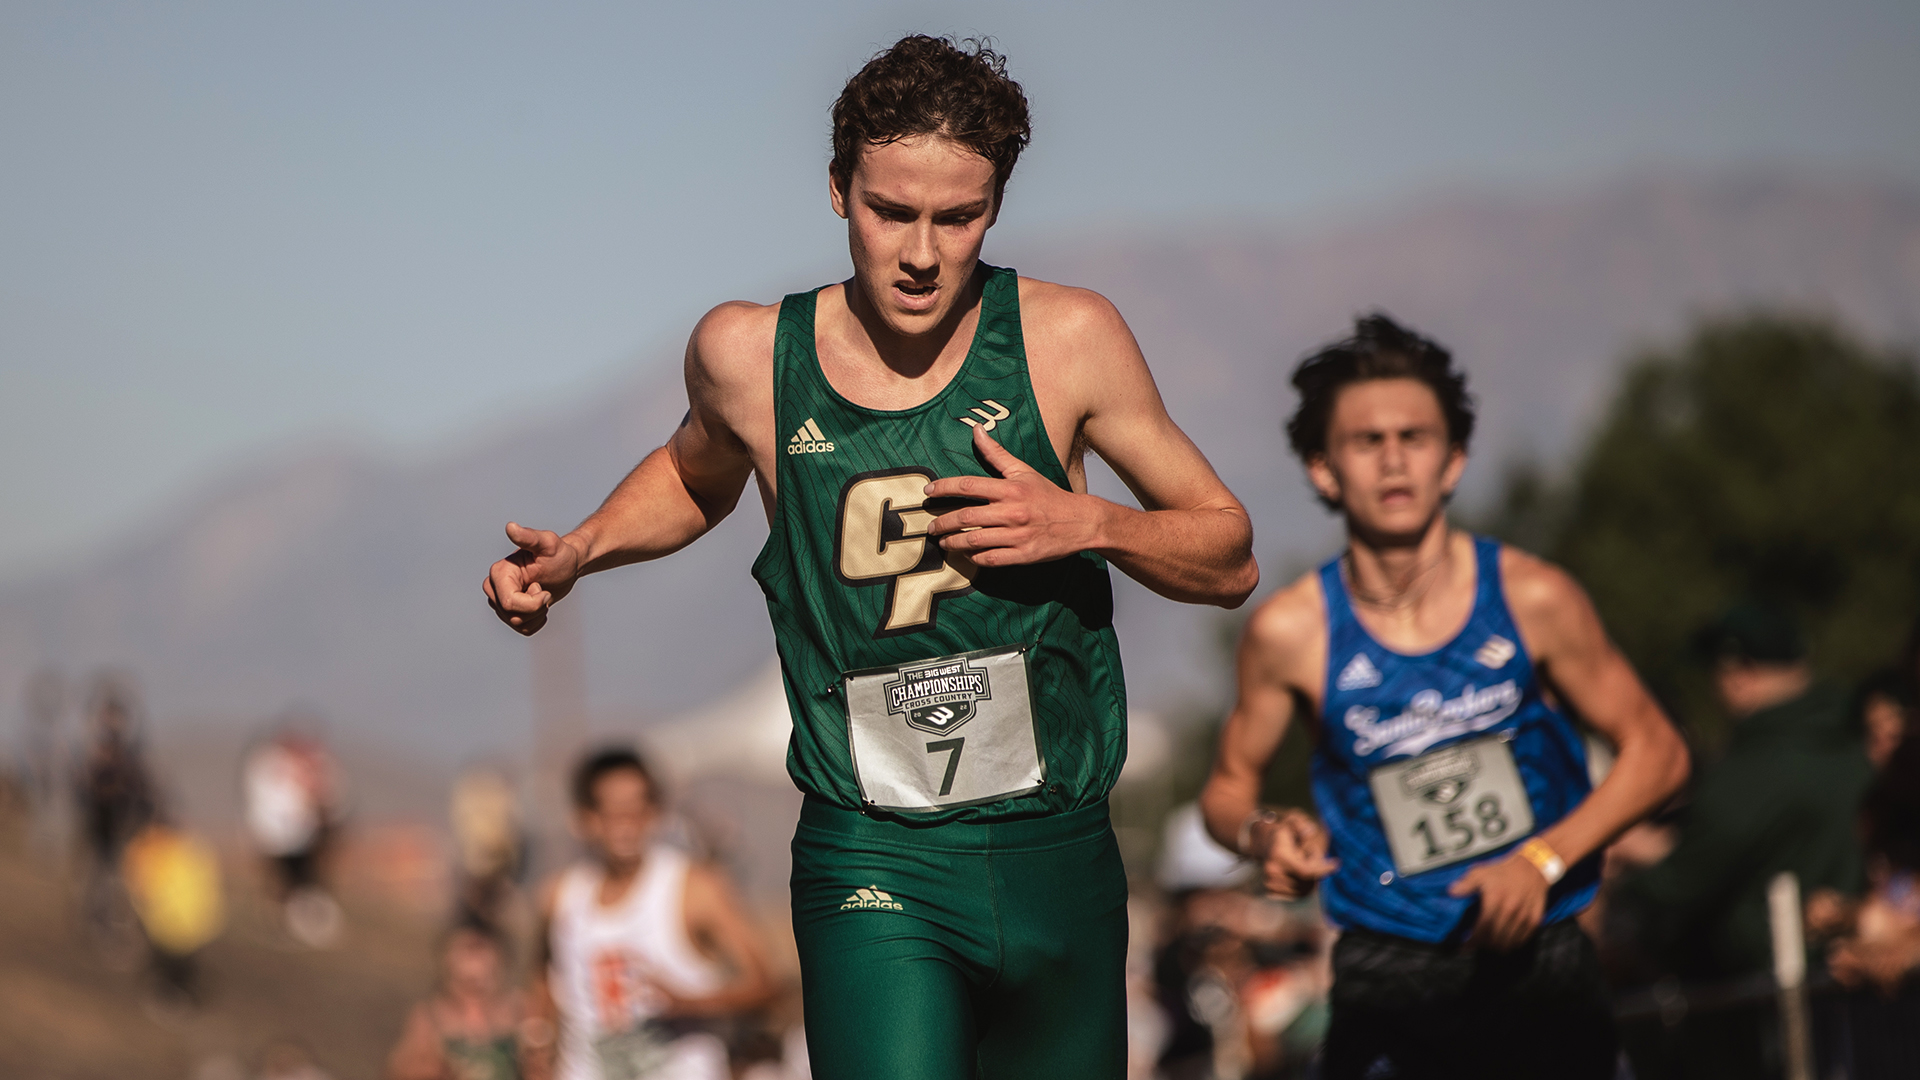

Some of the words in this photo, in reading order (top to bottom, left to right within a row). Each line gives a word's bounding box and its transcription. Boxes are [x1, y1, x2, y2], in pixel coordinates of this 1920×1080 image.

[787, 440, 835, 455] adidas
[906, 671, 924, 681] THE
[924, 668, 939, 679] BIG
[939, 665, 962, 676] WEST
[891, 674, 983, 707] CHAMPIONSHIPS
[905, 700, 932, 710] CROSS
[933, 692, 973, 703] COUNTRY
[925, 736, 965, 797] 7
[1409, 792, 1510, 858] 158
[840, 899, 904, 911] adidas
